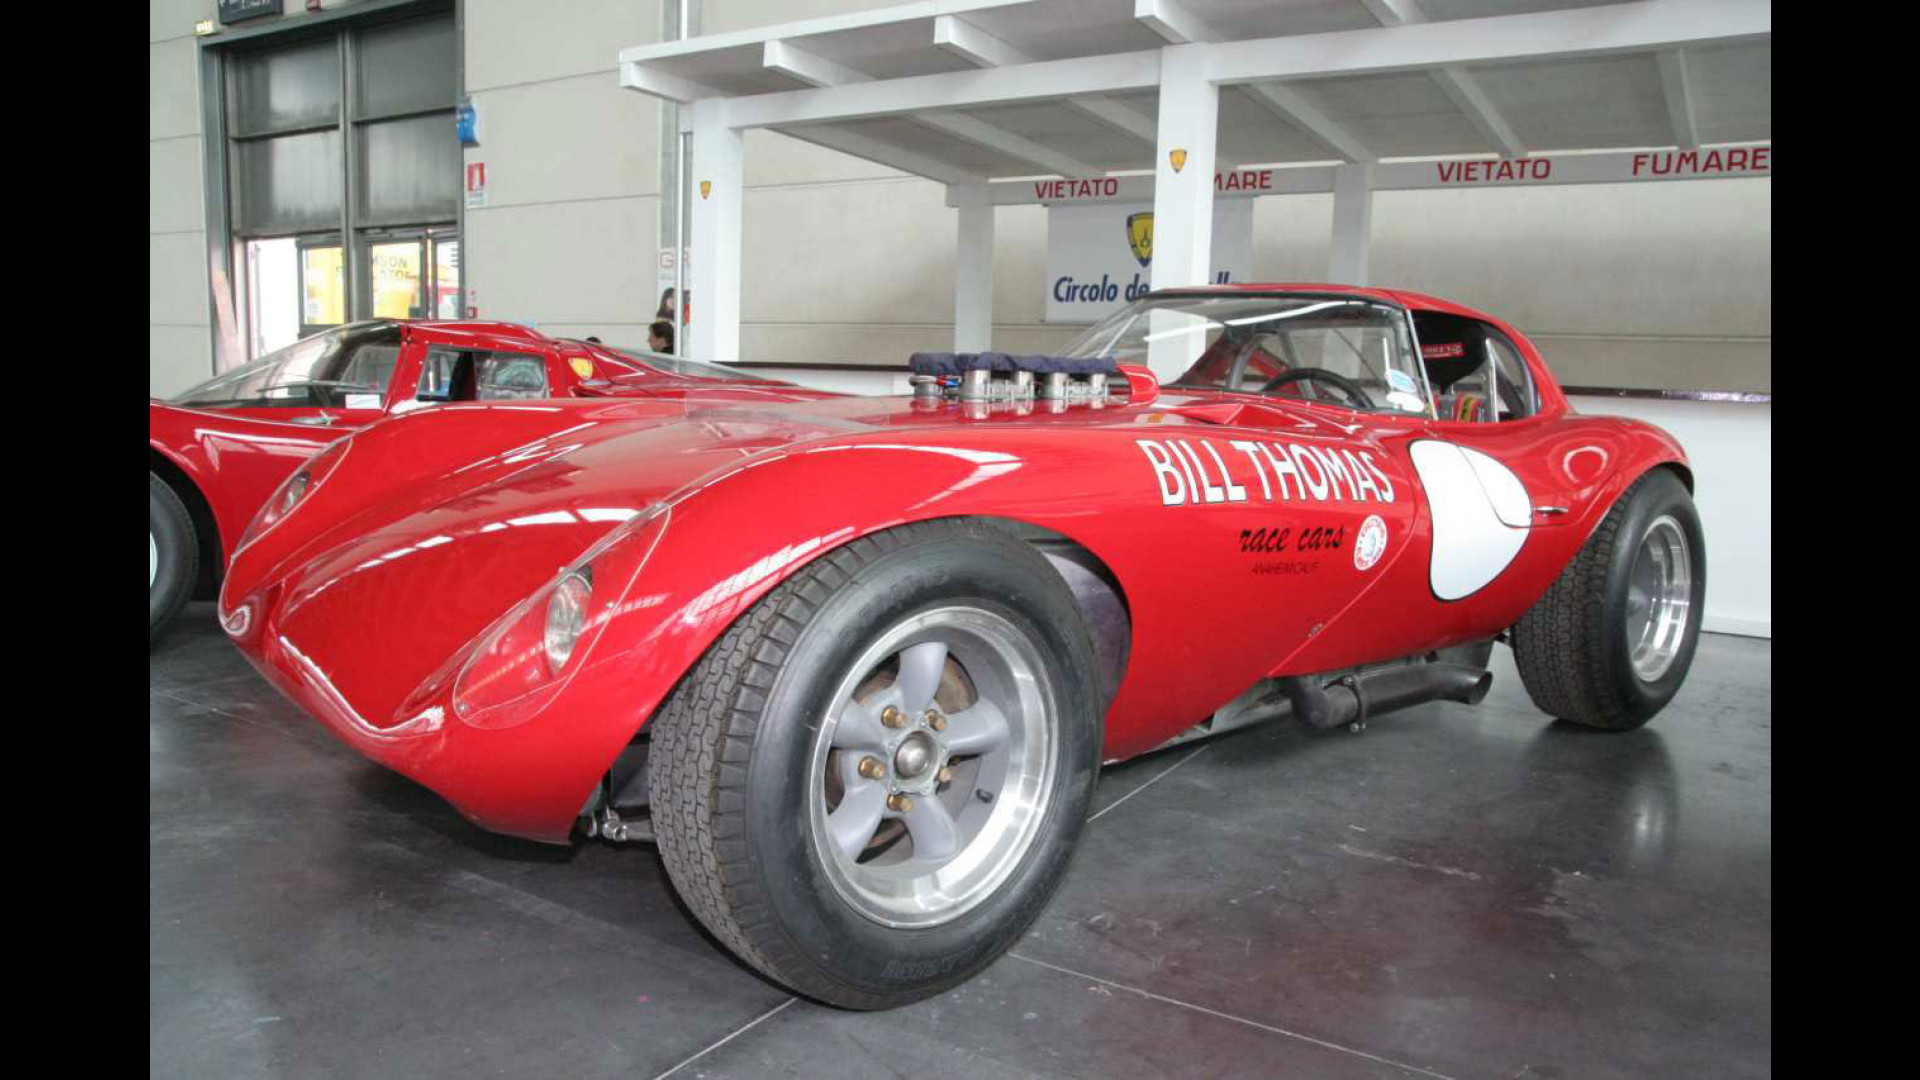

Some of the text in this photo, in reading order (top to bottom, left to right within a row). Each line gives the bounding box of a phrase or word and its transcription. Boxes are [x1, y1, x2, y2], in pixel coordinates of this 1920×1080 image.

[1435, 148, 1770, 182] VIETATO FUMARE
[1034, 178, 1118, 199] VIETATO
[1053, 274, 1118, 302] Circolo
[1136, 439, 1395, 507] BILL THOMAS
[1240, 526, 1290, 552] race
[1297, 526, 1345, 551] cars
